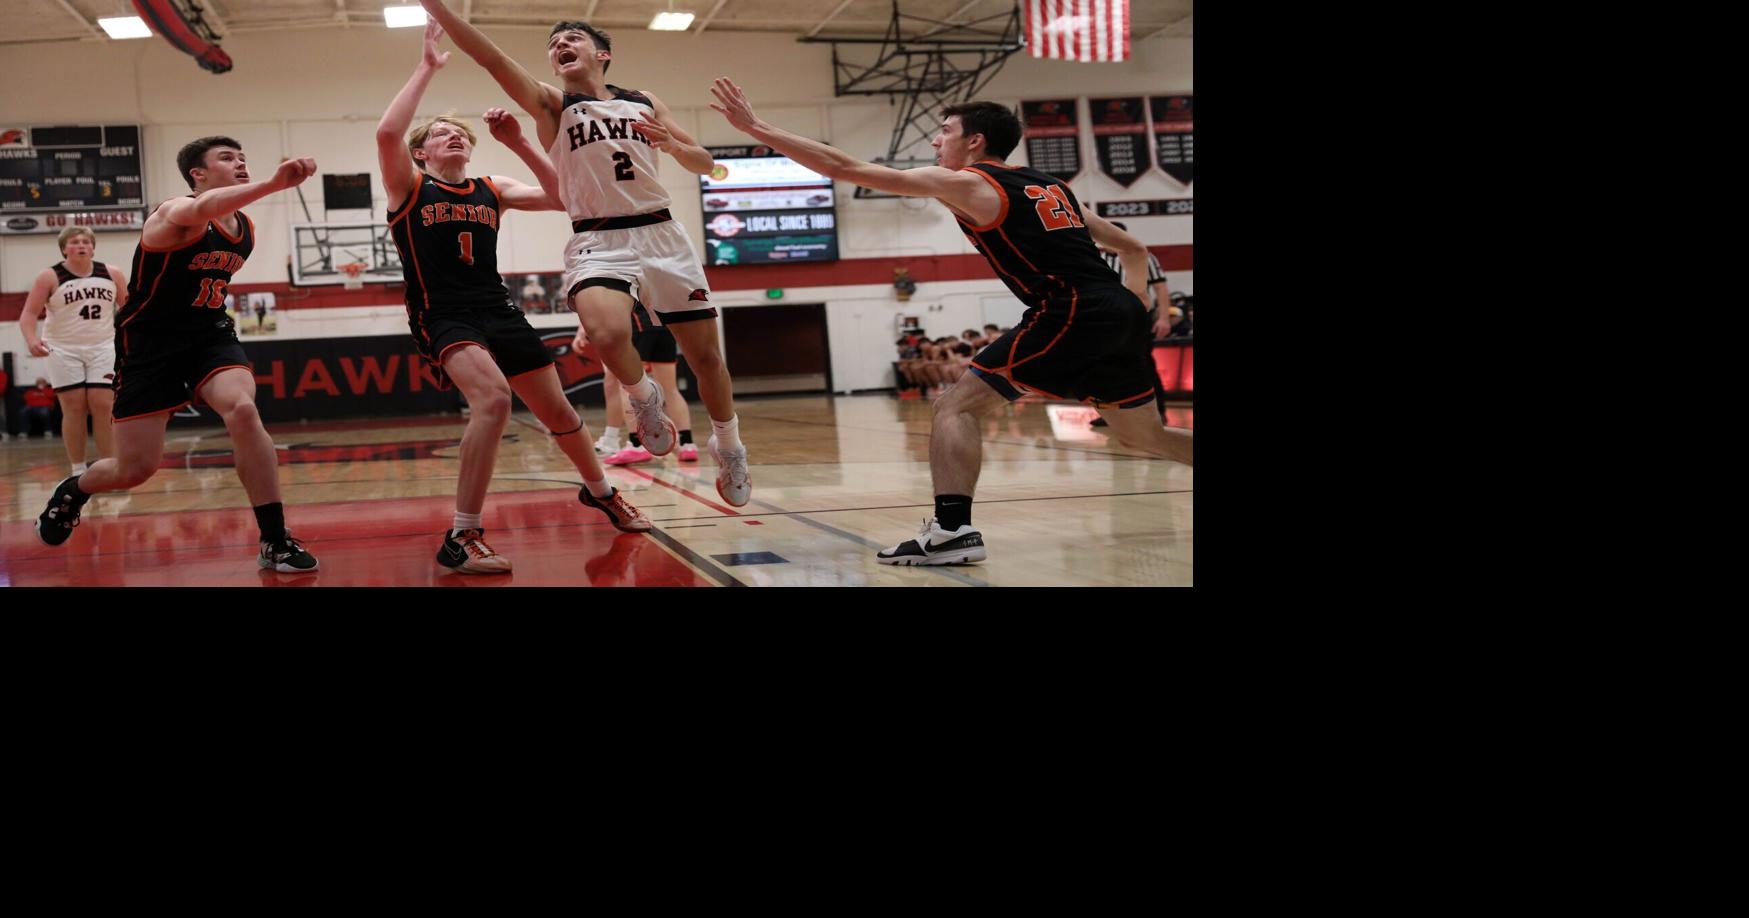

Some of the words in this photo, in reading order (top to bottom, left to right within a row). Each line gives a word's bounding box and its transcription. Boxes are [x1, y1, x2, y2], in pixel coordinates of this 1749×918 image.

[567, 117, 654, 152] HAWK
[54, 152, 82, 160] PERIOD
[100, 146, 134, 157] GUEST
[612, 151, 635, 181] 2
[1024, 185, 1084, 231] 21
[1107, 203, 1148, 215] 2023
[46, 215, 67, 227] GO
[74, 212, 135, 226] HAWKS!
[746, 216, 778, 232] LOCAL
[779, 214, 809, 230] SINCE
[458, 232, 474, 265] 1
[188, 251, 246, 275] SENIO
[63, 287, 113, 304] HAWKS
[79, 305, 102, 320] 42
[250, 354, 446, 399] HAWK
